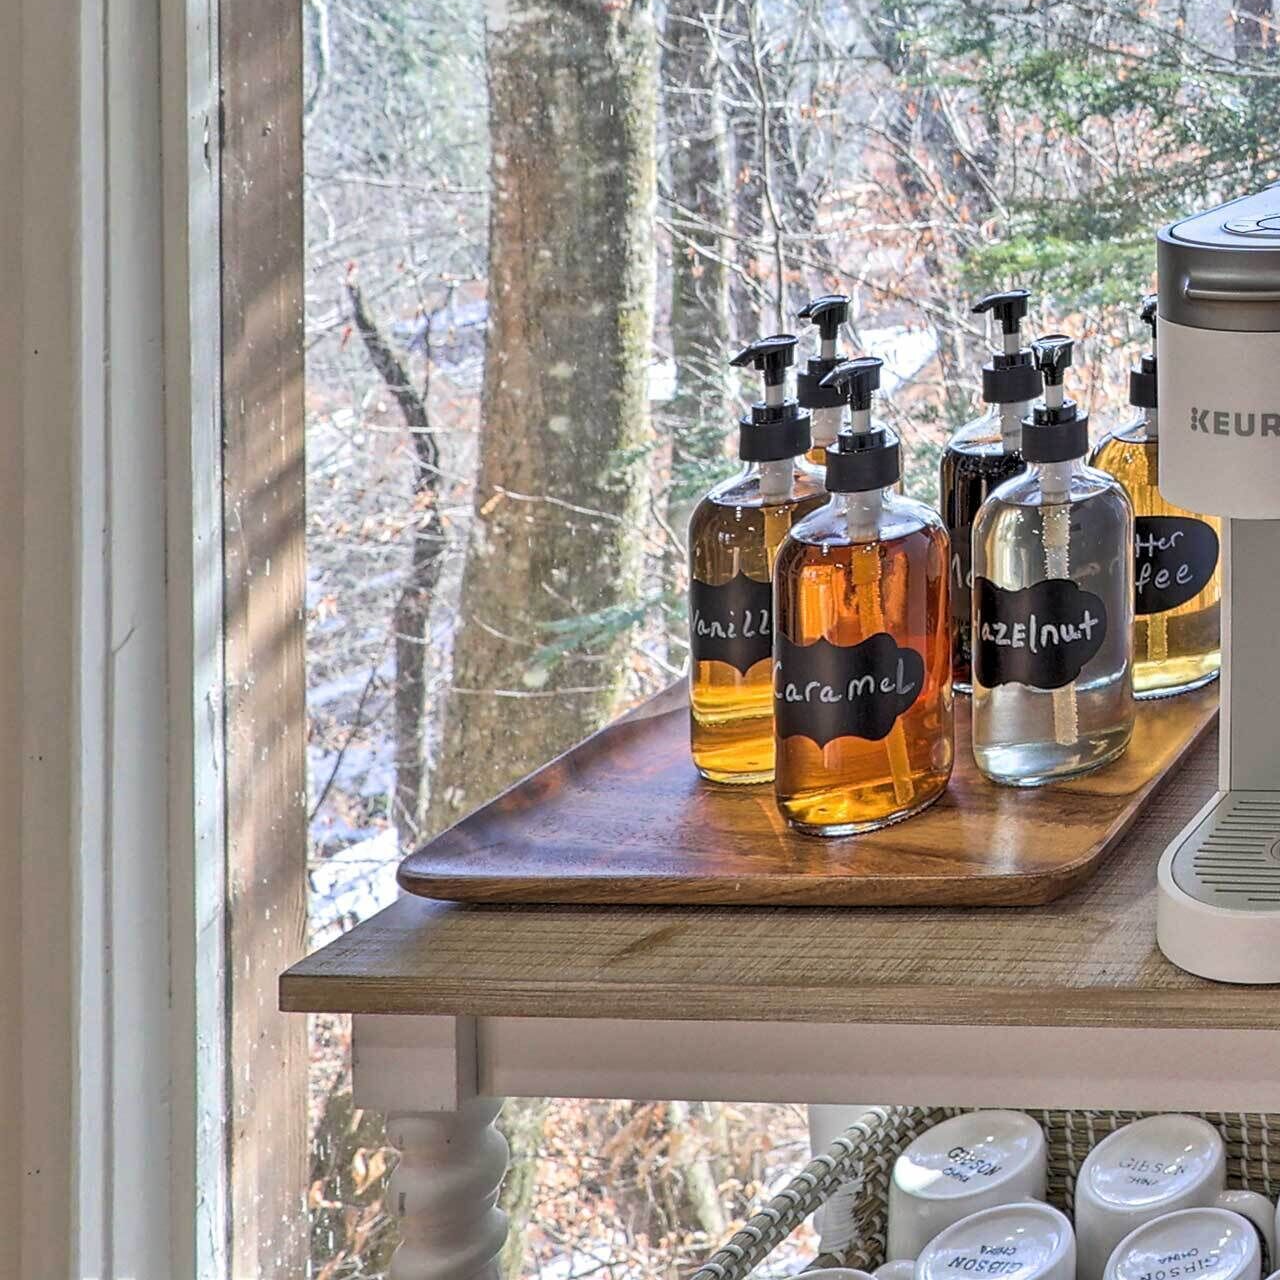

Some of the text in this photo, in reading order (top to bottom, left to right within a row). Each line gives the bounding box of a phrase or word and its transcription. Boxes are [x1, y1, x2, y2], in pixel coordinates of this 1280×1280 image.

[689, 606, 770, 638] Vanill
[948, 1146, 1002, 1176] GSON
[948, 1257, 1023, 1274] GIBSON
